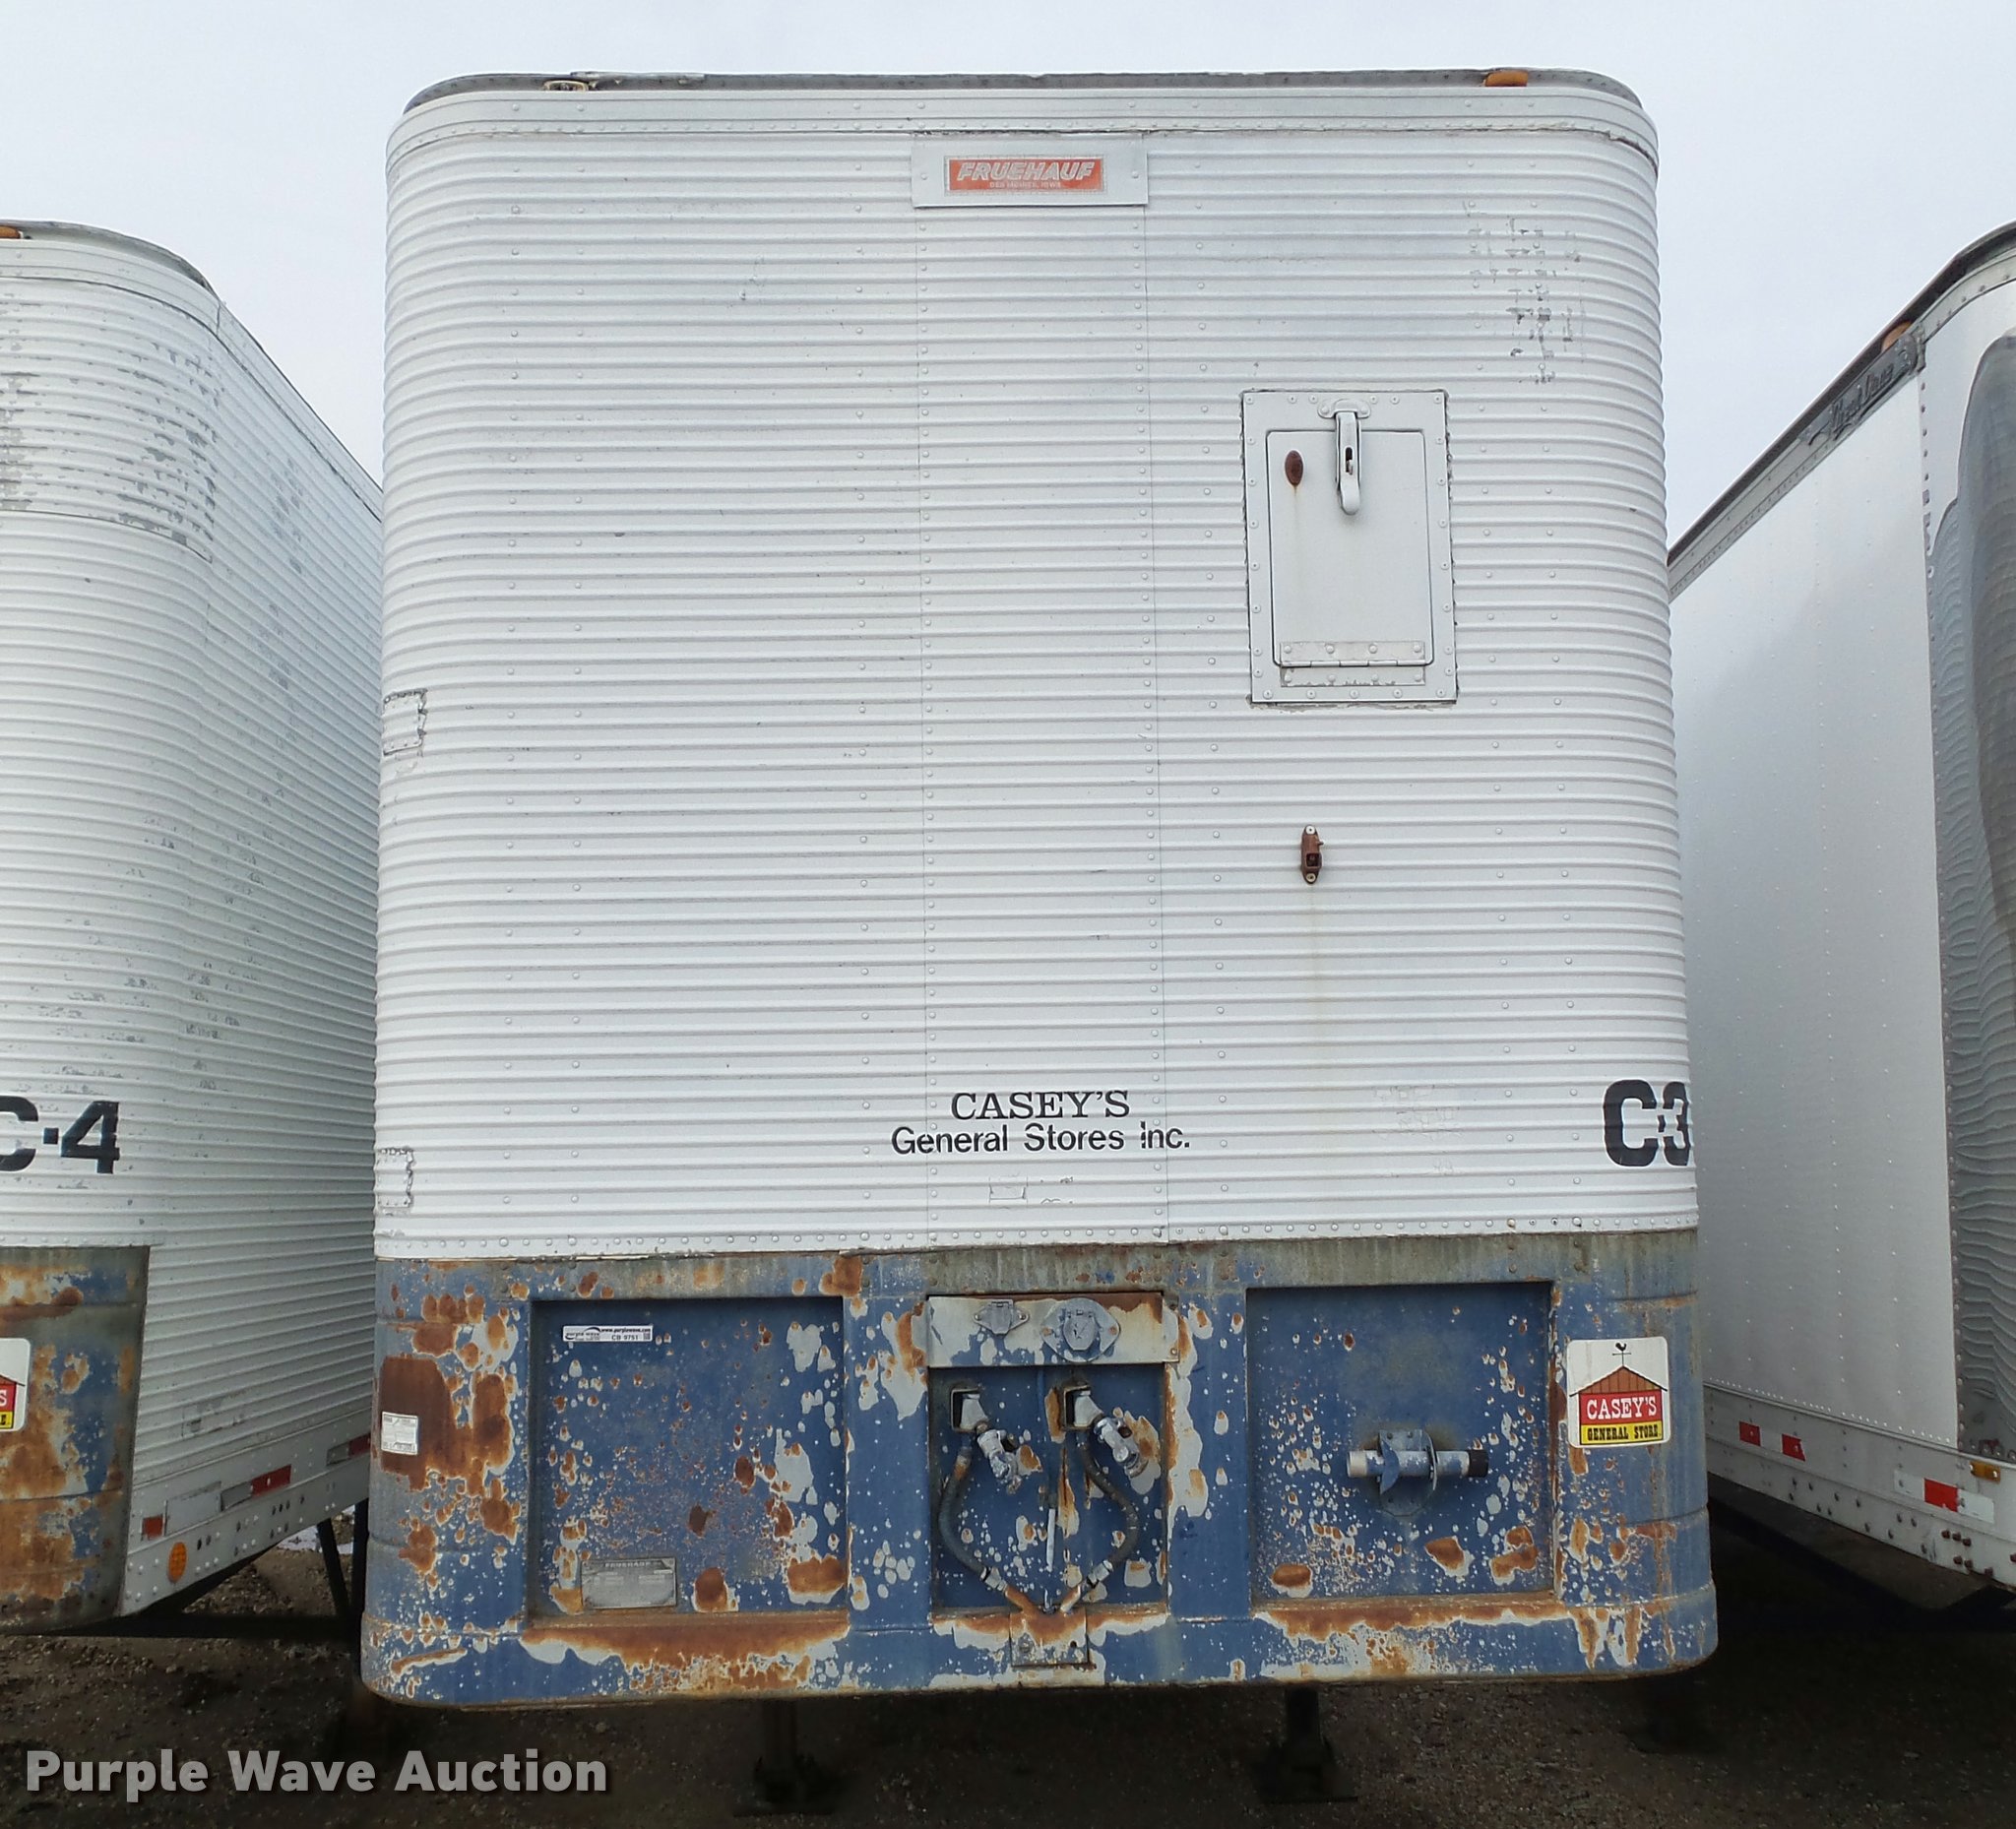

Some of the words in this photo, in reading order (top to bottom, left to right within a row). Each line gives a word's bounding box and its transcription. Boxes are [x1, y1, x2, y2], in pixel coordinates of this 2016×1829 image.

[957, 161, 1096, 181] FRUEHAUF
[951, 1090, 1131, 1120] CASEY'S
[891, 1124, 1009, 1155] General
[1024, 1122, 1125, 1152] Stores
[1587, 1396, 1658, 1419] CASEY'S
[1587, 1425, 1629, 1441] GENERAL
[1634, 1424, 1659, 1439] STORE
